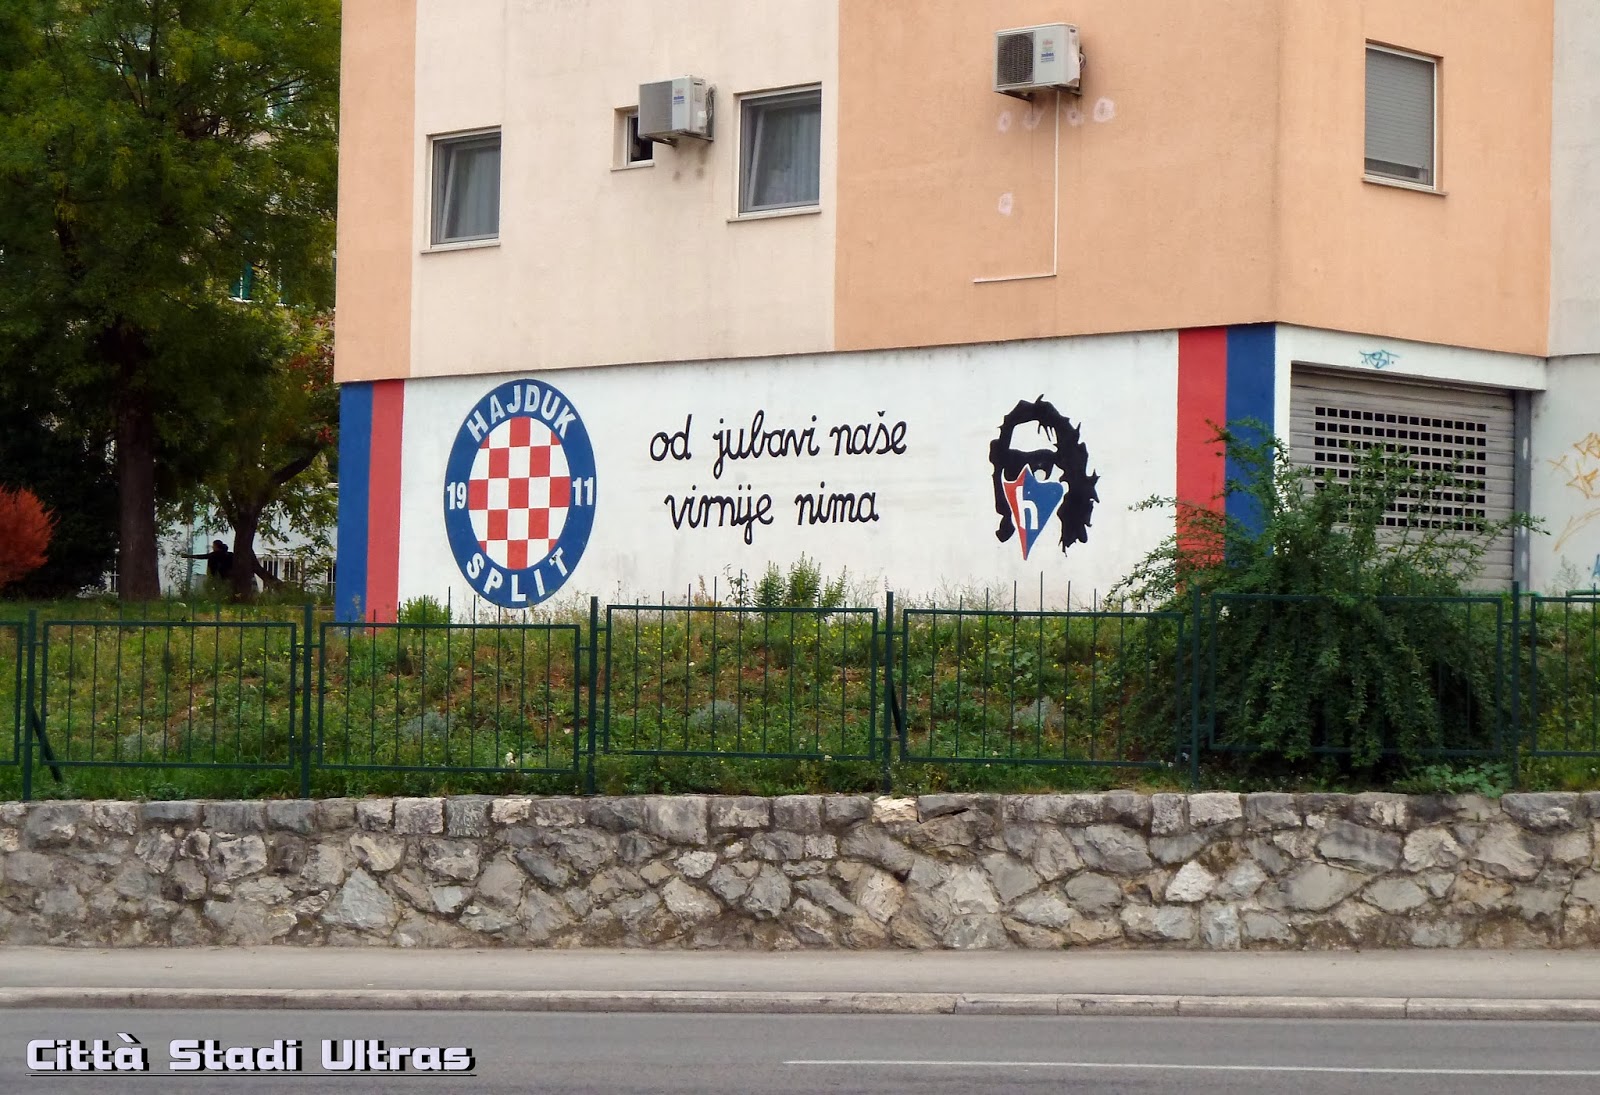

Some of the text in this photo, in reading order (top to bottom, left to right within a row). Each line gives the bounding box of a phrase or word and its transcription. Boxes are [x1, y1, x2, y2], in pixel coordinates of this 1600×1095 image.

[466, 384, 576, 442] HAJDUK
[649, 409, 908, 479] od jubavi naše
[447, 476, 594, 510] 19 11
[794, 481, 880, 526] nima
[466, 547, 568, 602] SPLIT
